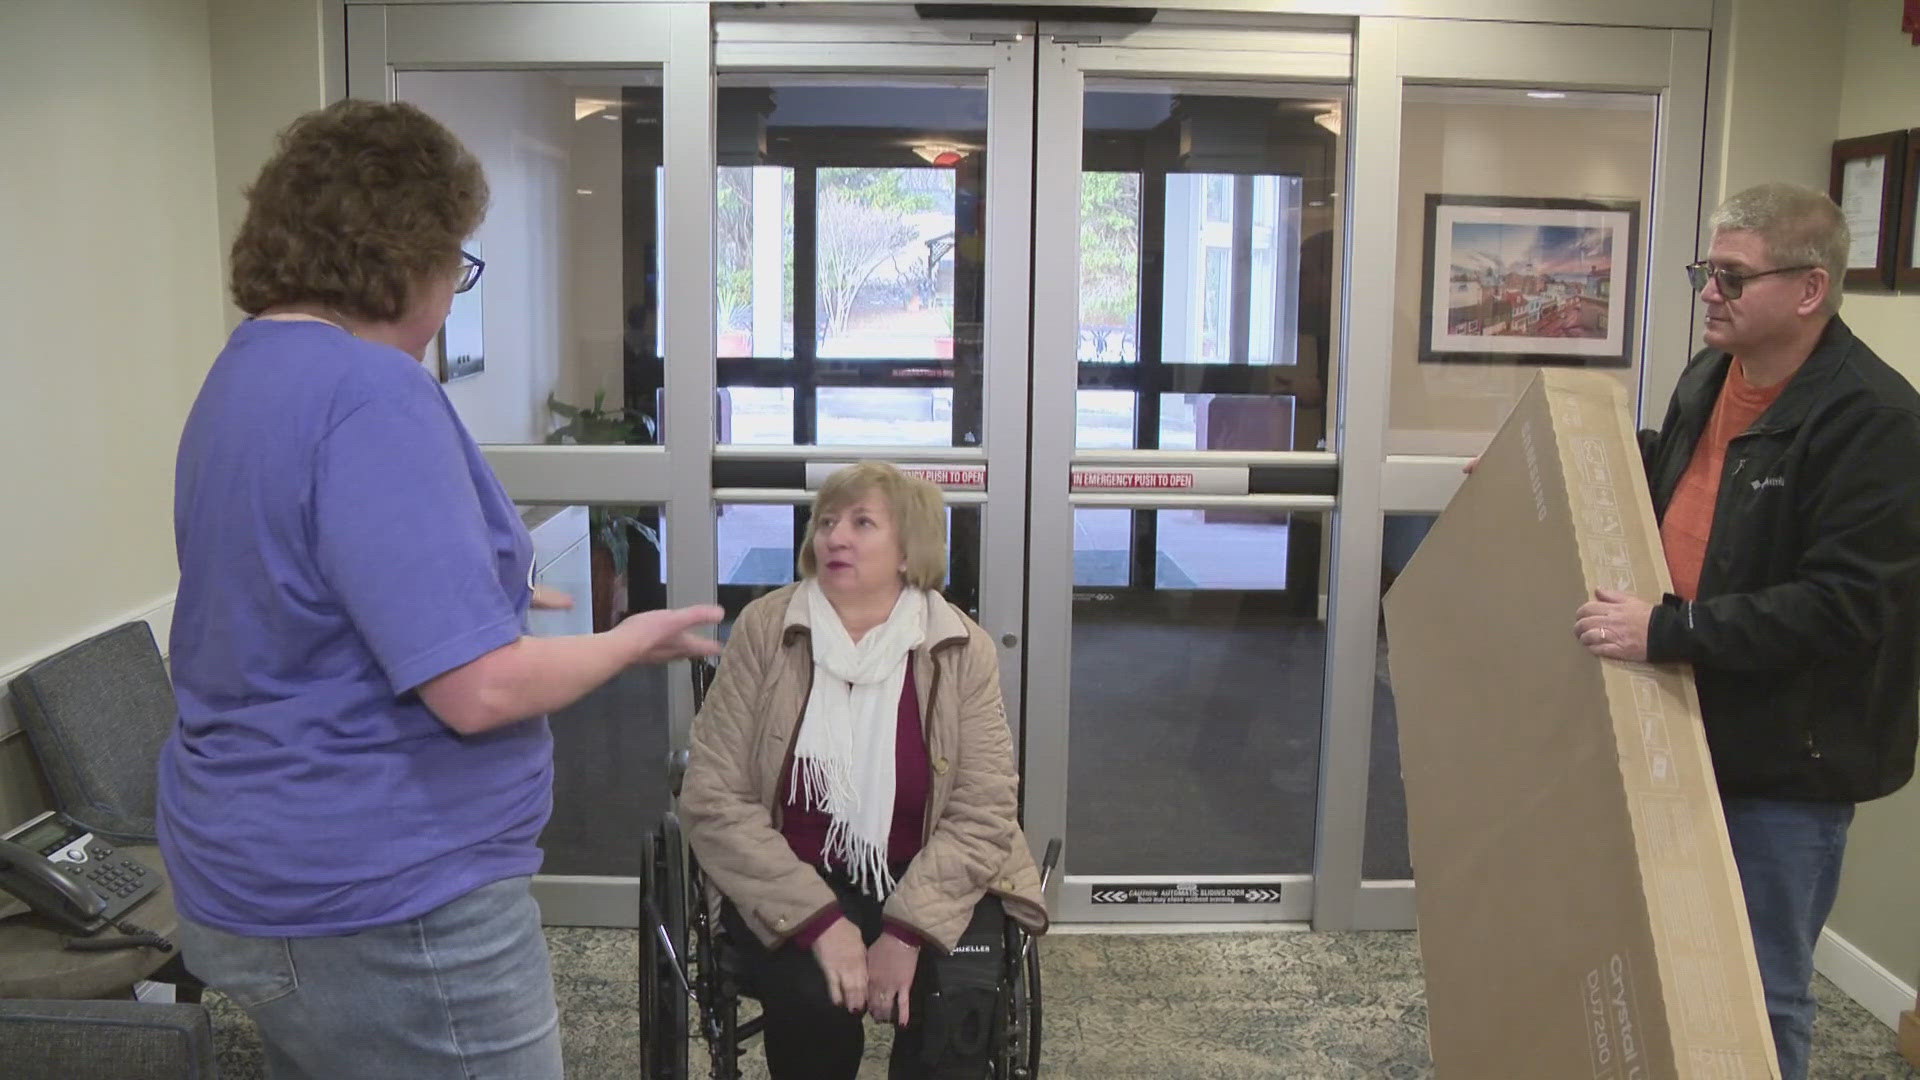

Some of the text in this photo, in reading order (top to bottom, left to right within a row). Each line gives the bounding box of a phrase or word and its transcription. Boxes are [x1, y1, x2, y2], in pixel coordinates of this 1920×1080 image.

[926, 470, 948, 482] PUSH
[950, 471, 960, 483] TO
[961, 471, 984, 483] OPEN
[1073, 474, 1192, 487] IN EMERGENCY PUSH TO OPEN
[1522, 421, 1547, 521] SAMSUNG
[1587, 968, 1610, 1065] DU7200
[1611, 953, 1638, 1063] Crystal
